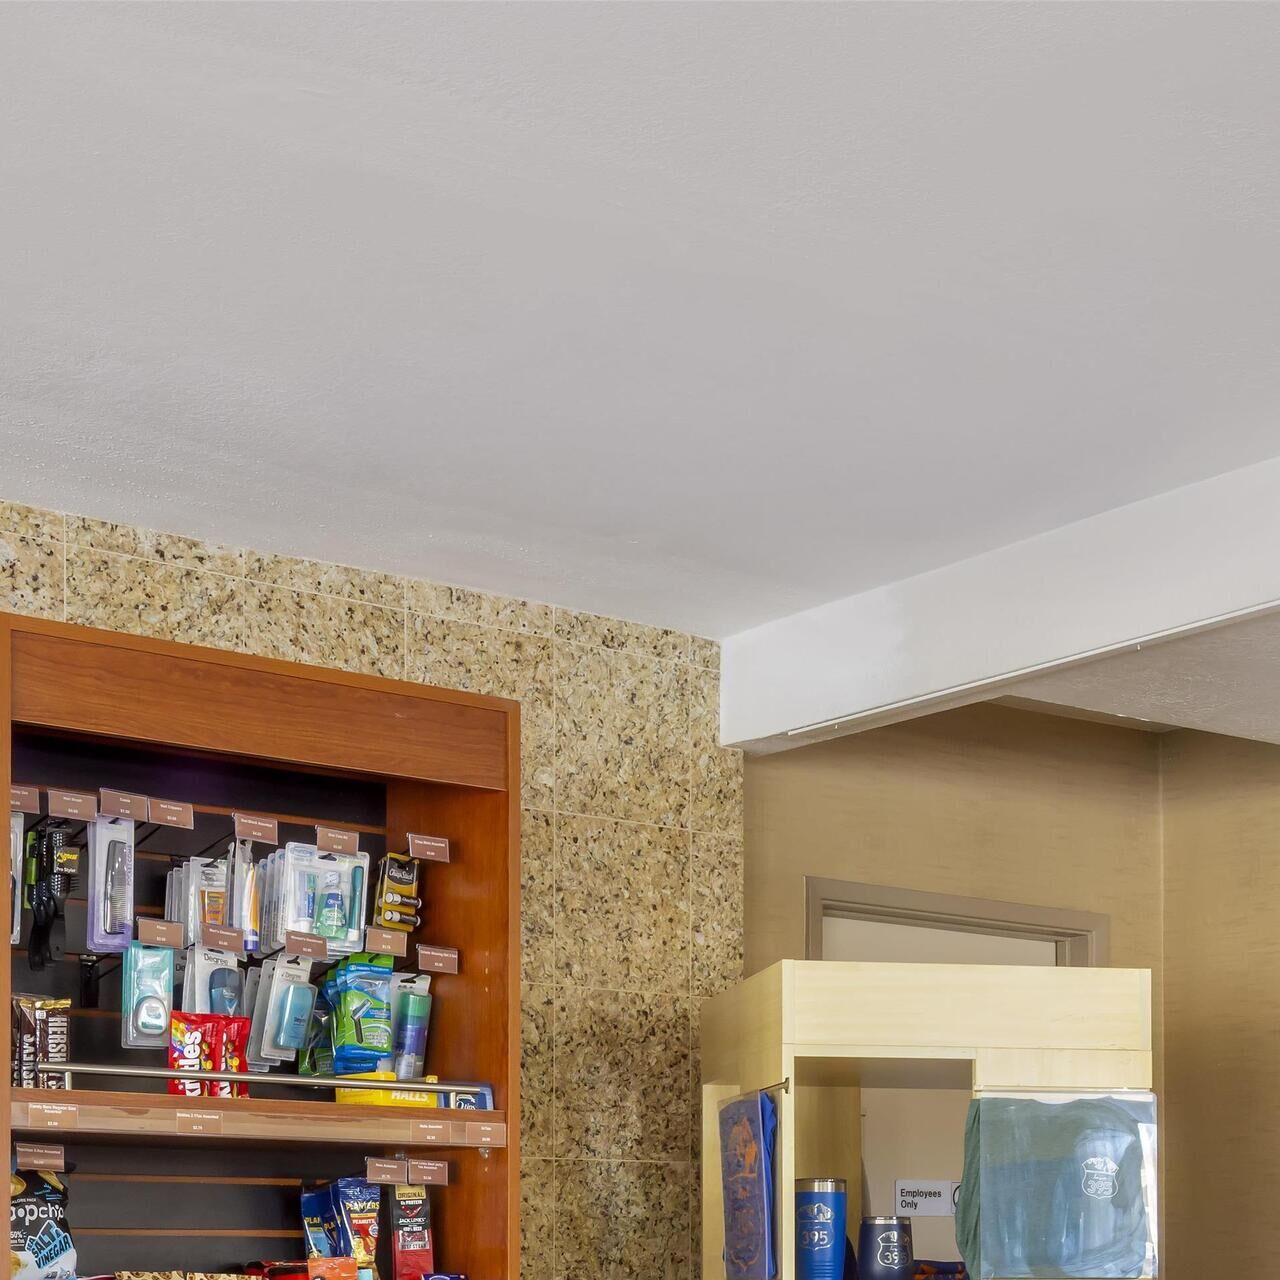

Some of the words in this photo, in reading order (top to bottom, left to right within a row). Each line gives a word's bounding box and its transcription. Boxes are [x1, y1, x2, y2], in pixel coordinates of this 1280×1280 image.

[388, 867, 414, 882] ChapStick
[203, 952, 229, 966] Degree
[391, 1090, 429, 1102] HALLS
[397, 1191, 425, 1199] ORIGINAL
[900, 1188, 942, 1199] Employees
[900, 1199, 918, 1210] Only
[31, 1224, 56, 1259] SALT
[801, 1231, 829, 1245] 395
[35, 1233, 72, 1270] VINEGAR
